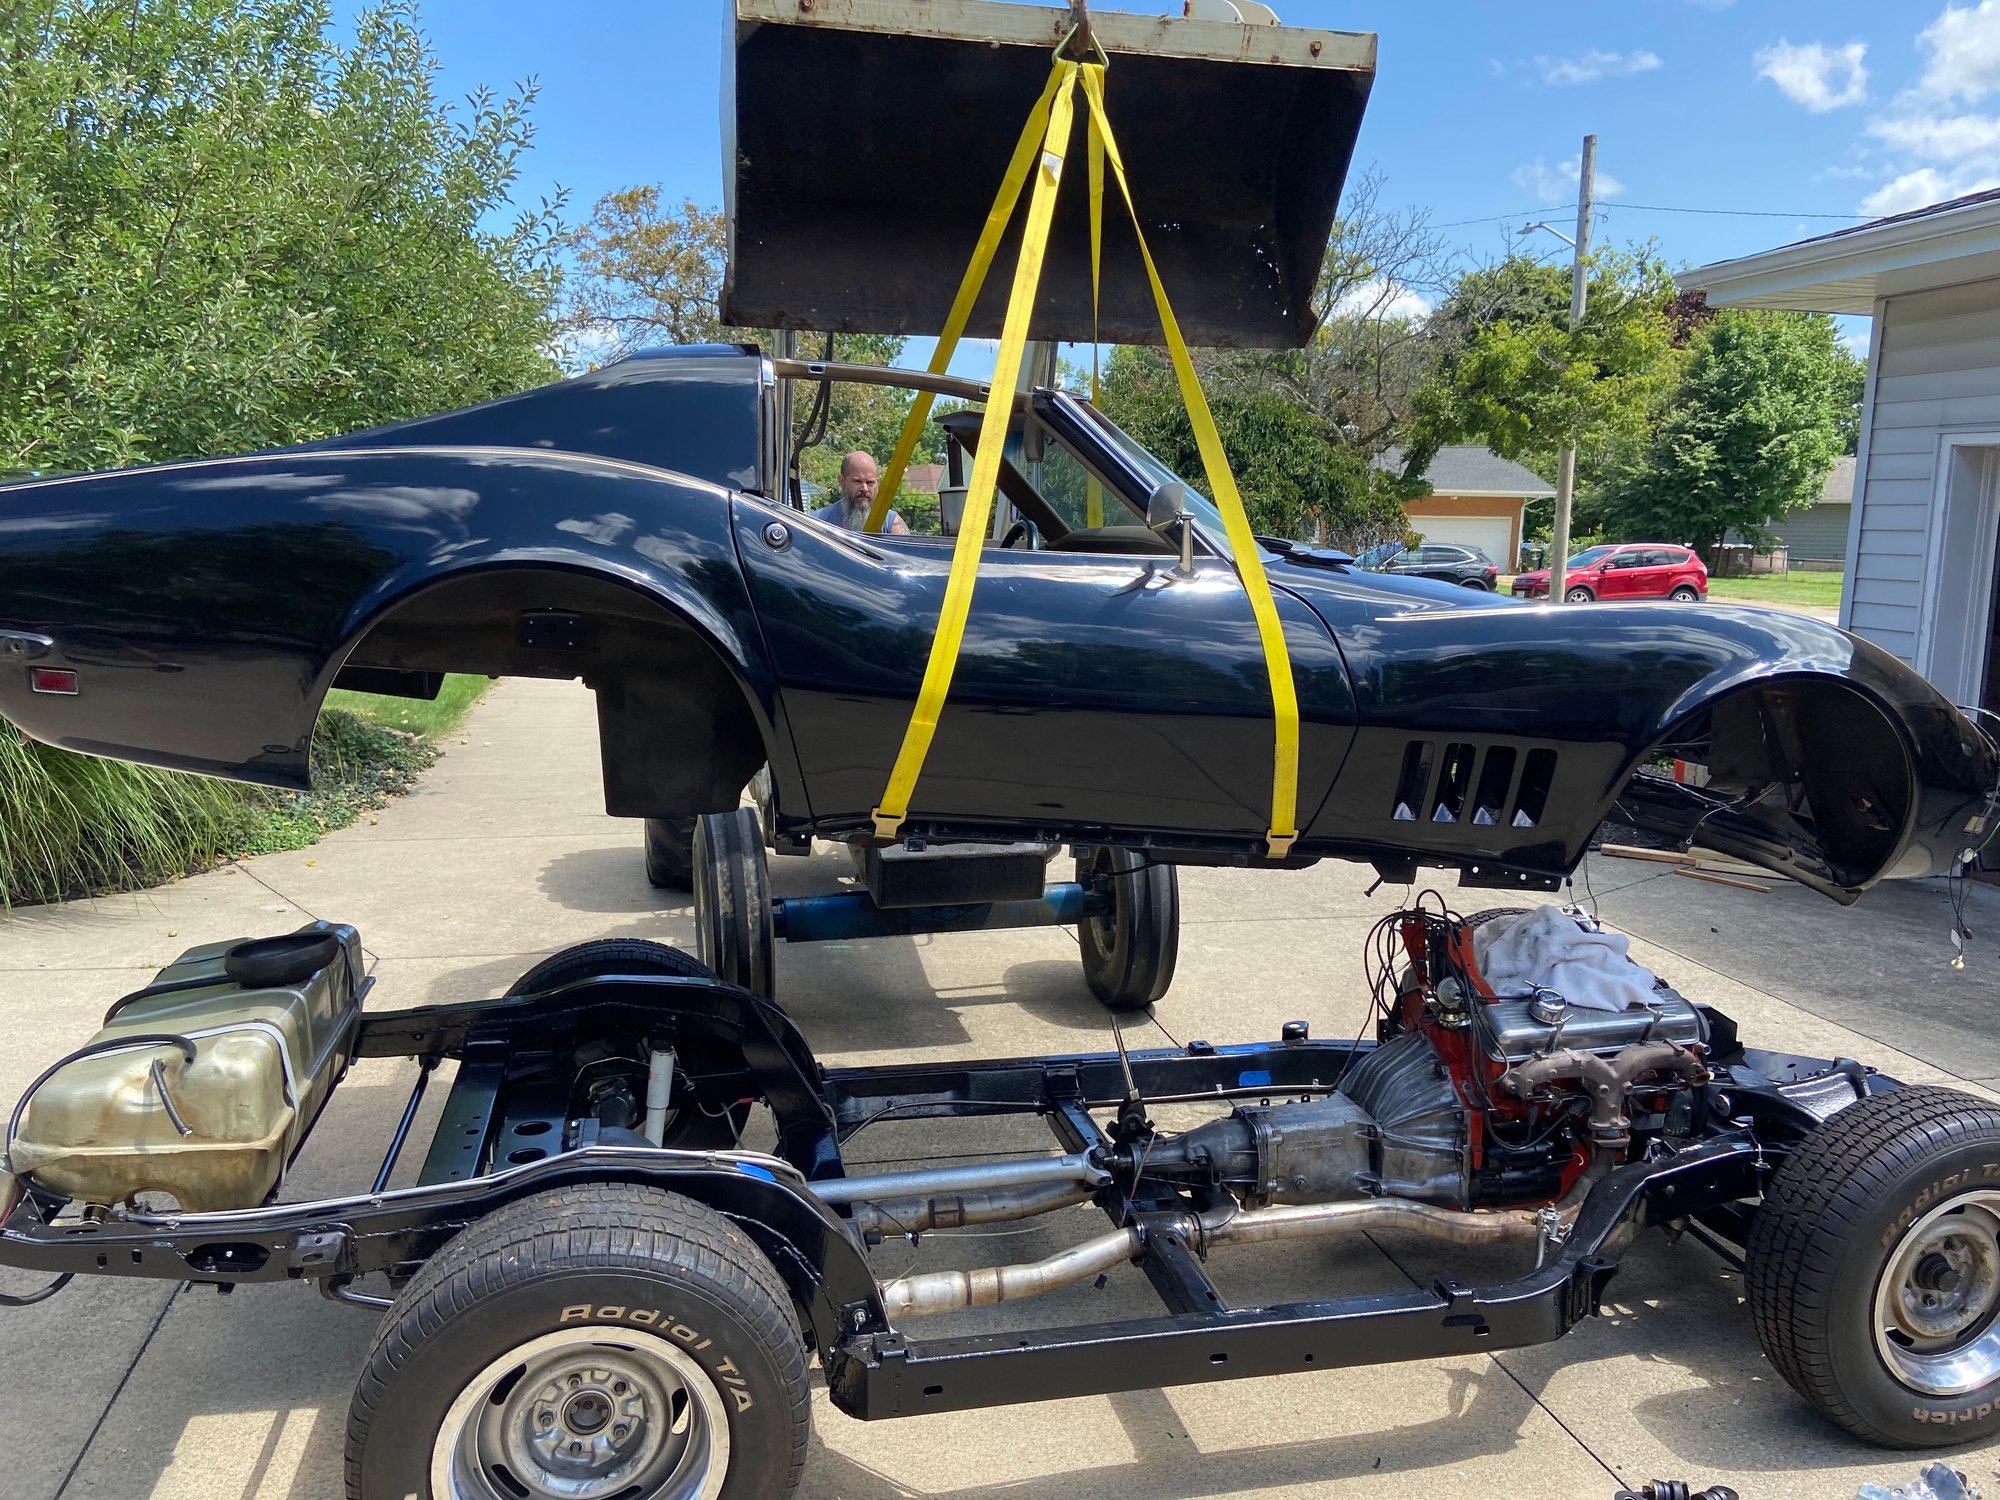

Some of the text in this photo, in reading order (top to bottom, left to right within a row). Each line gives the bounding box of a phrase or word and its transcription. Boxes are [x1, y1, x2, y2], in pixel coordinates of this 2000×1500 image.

[1881, 1168, 1970, 1247] Radial
[561, 1304, 753, 1413] Radial T/A
